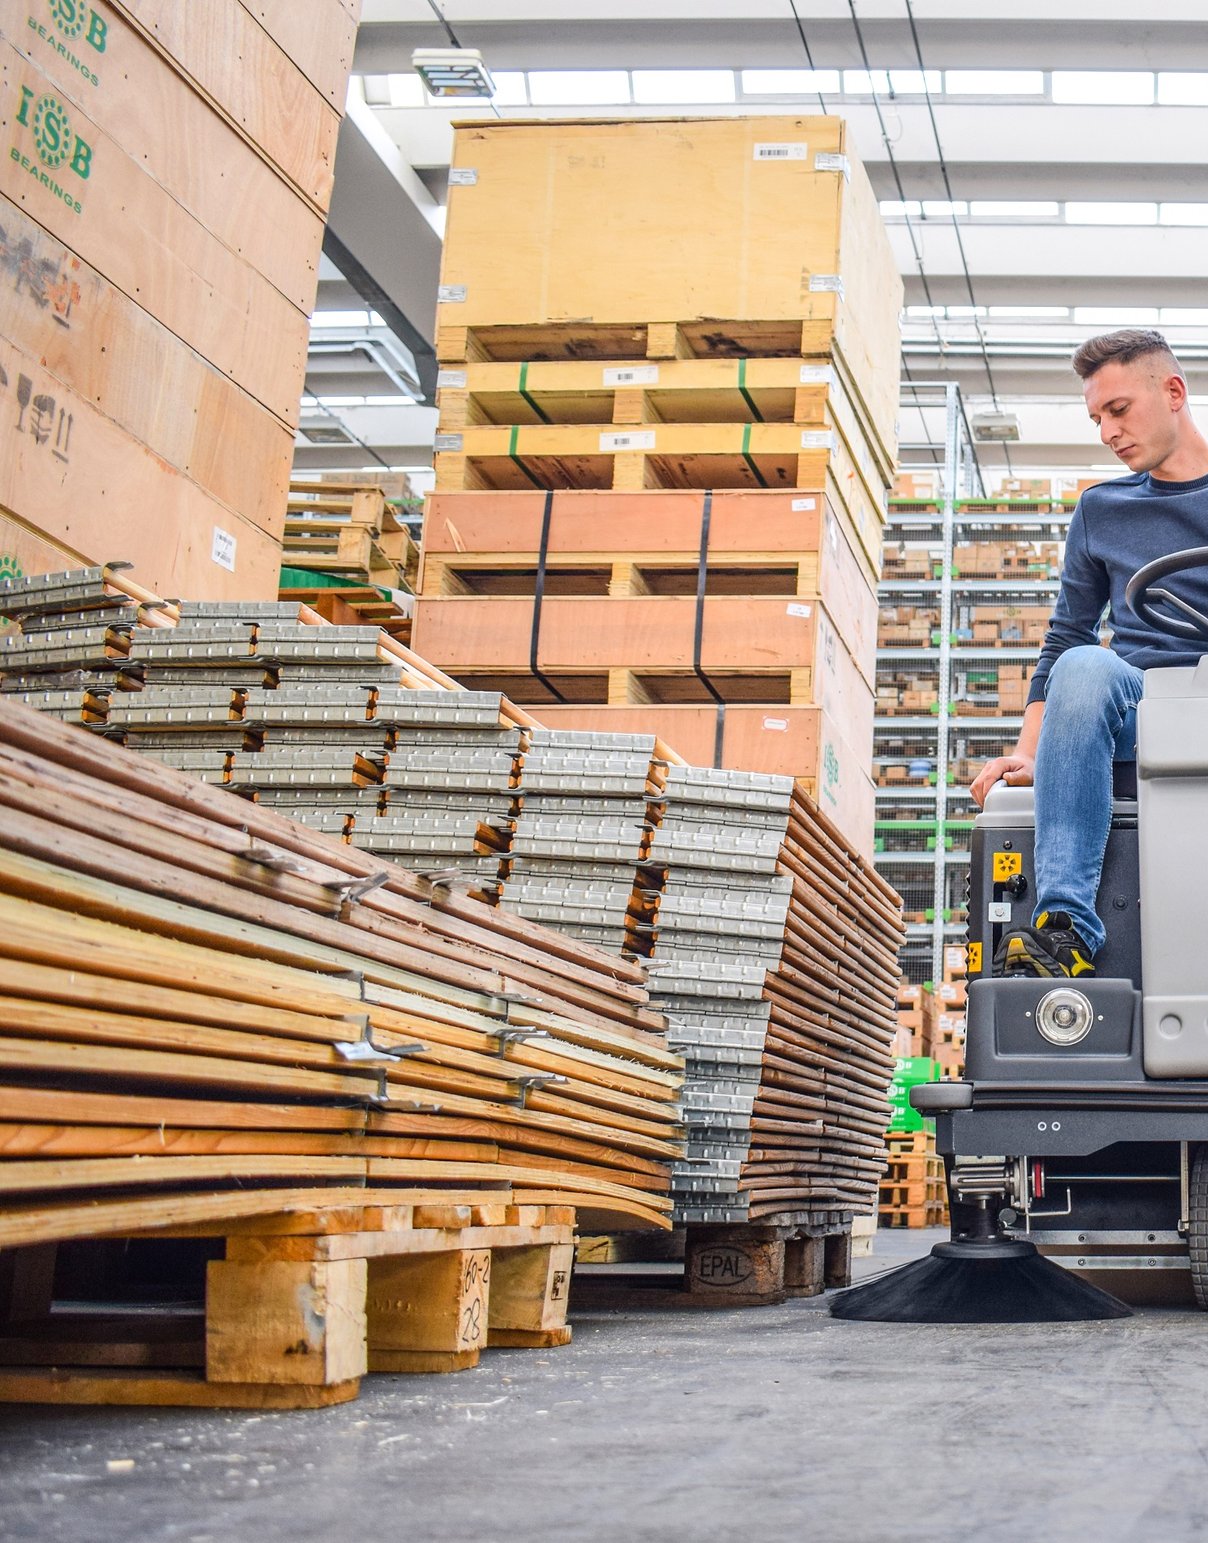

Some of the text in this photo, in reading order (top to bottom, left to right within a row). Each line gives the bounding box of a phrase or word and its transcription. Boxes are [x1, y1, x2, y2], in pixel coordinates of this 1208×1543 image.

[27, 16, 99, 87] BEARINGS
[50, 0, 108, 54] SB
[16, 84, 93, 180] ISB
[9, 147, 83, 214] BEARINGS
[700, 1255, 745, 1277] EPAL
